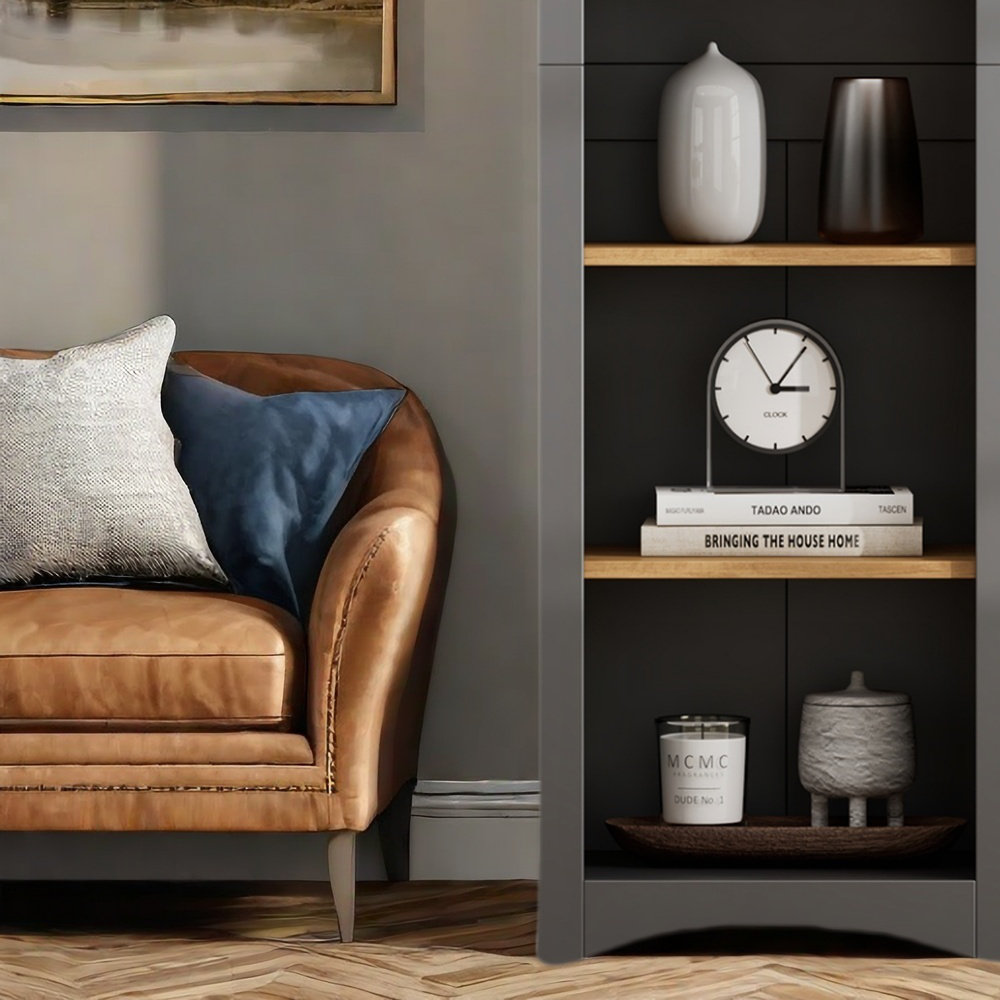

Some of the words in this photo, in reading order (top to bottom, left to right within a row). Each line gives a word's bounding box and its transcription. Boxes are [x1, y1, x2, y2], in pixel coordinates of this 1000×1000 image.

[751, 505, 788, 515] TADAO
[790, 505, 821, 515] ANDO
[704, 534, 759, 548] BRINGING
[763, 534, 785, 548] THE
[788, 534, 825, 548] HOUSE
[827, 534, 860, 548] HOME
